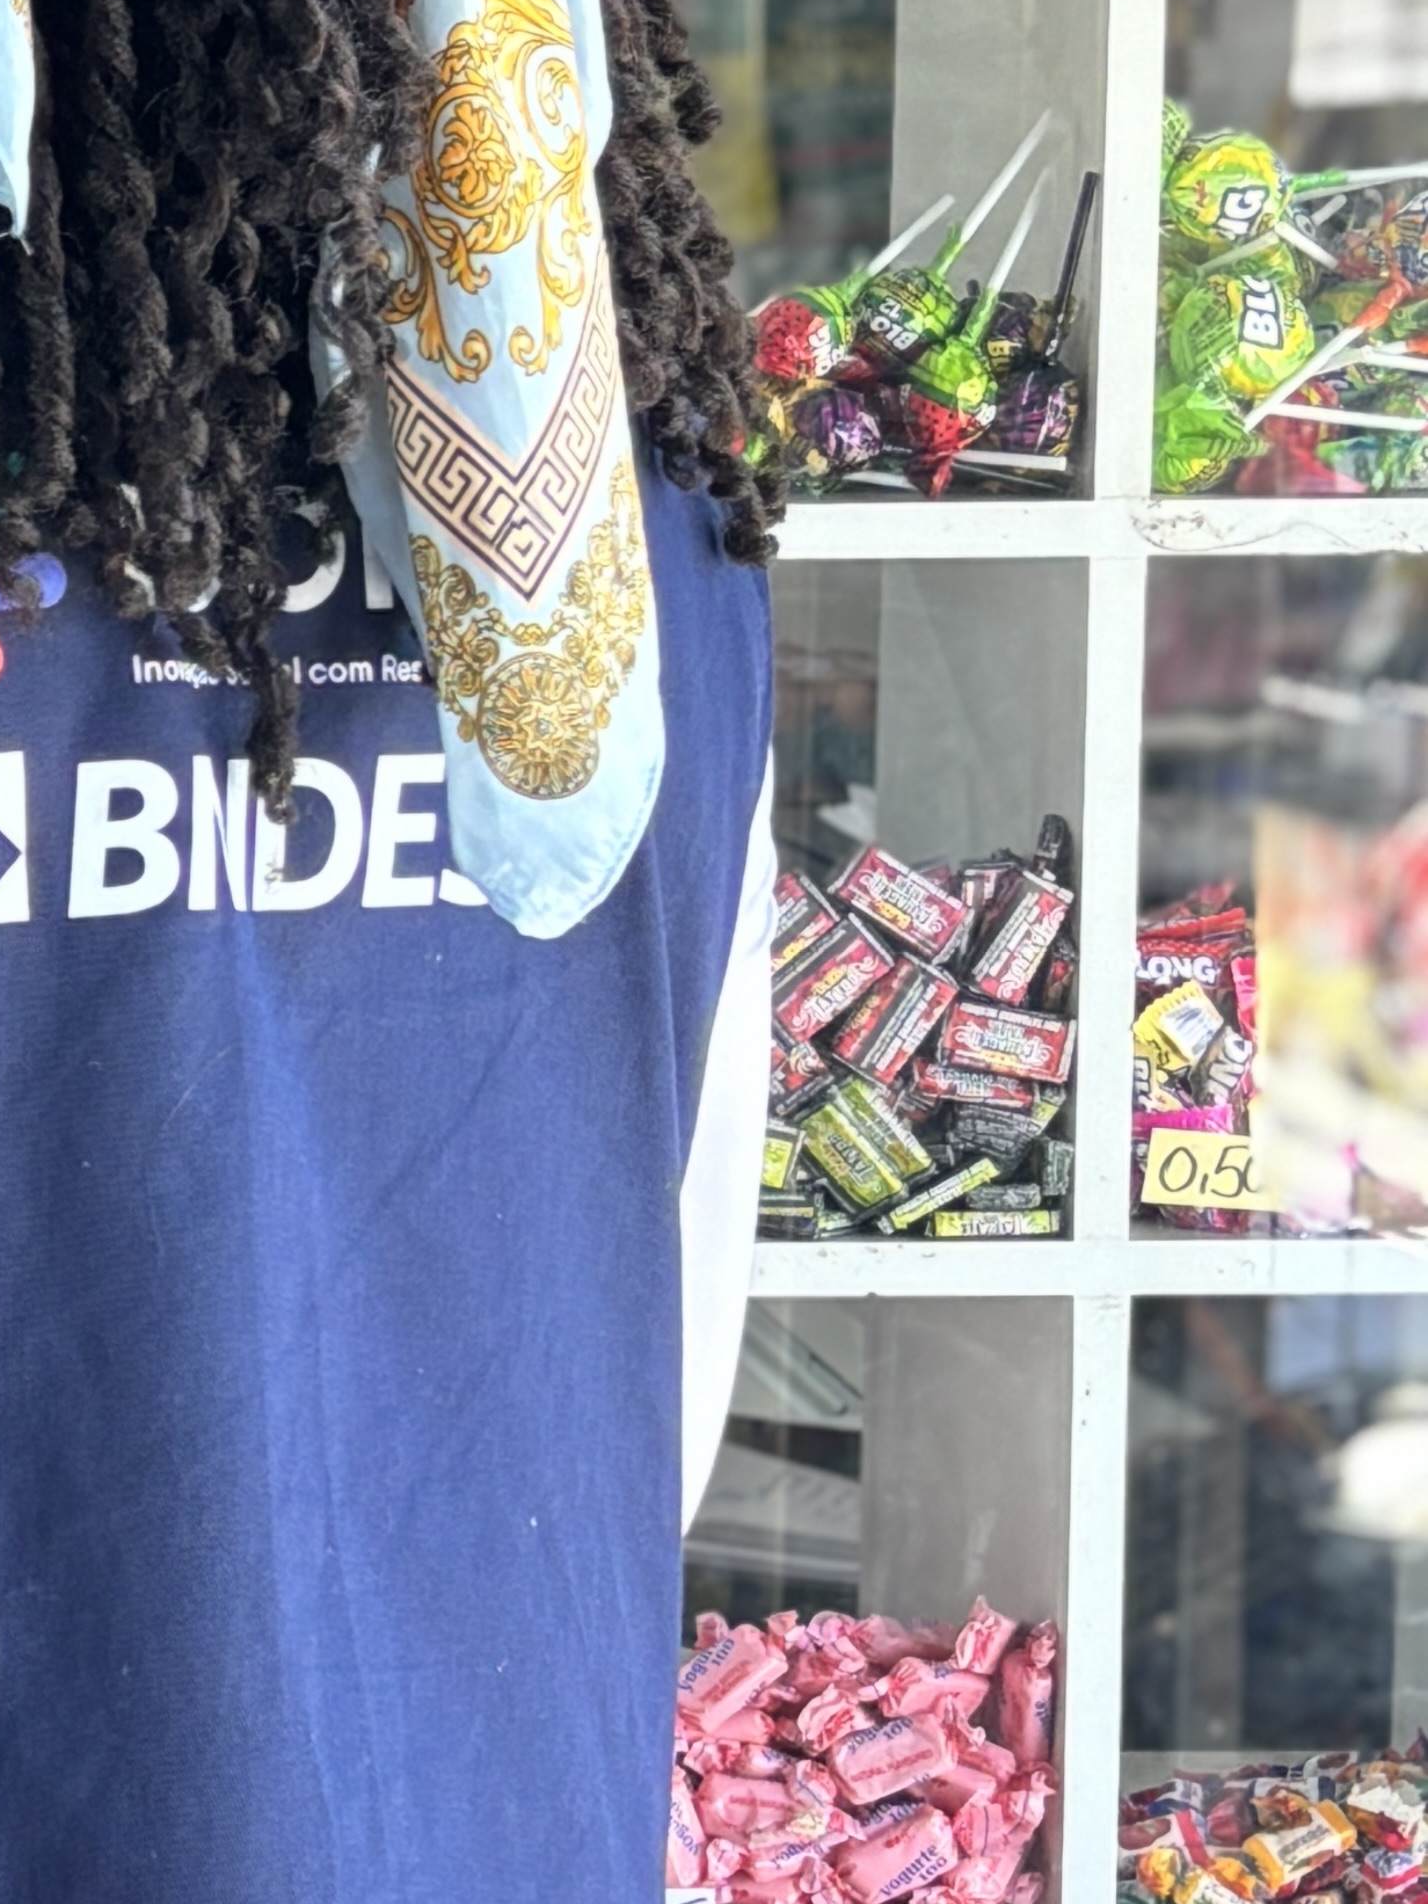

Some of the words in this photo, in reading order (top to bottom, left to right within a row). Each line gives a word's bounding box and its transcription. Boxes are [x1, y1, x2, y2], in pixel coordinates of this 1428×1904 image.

[308, 662, 374, 684] com
[67, 752, 491, 920] BNDE
[919, 1856, 948, 1881] 100
